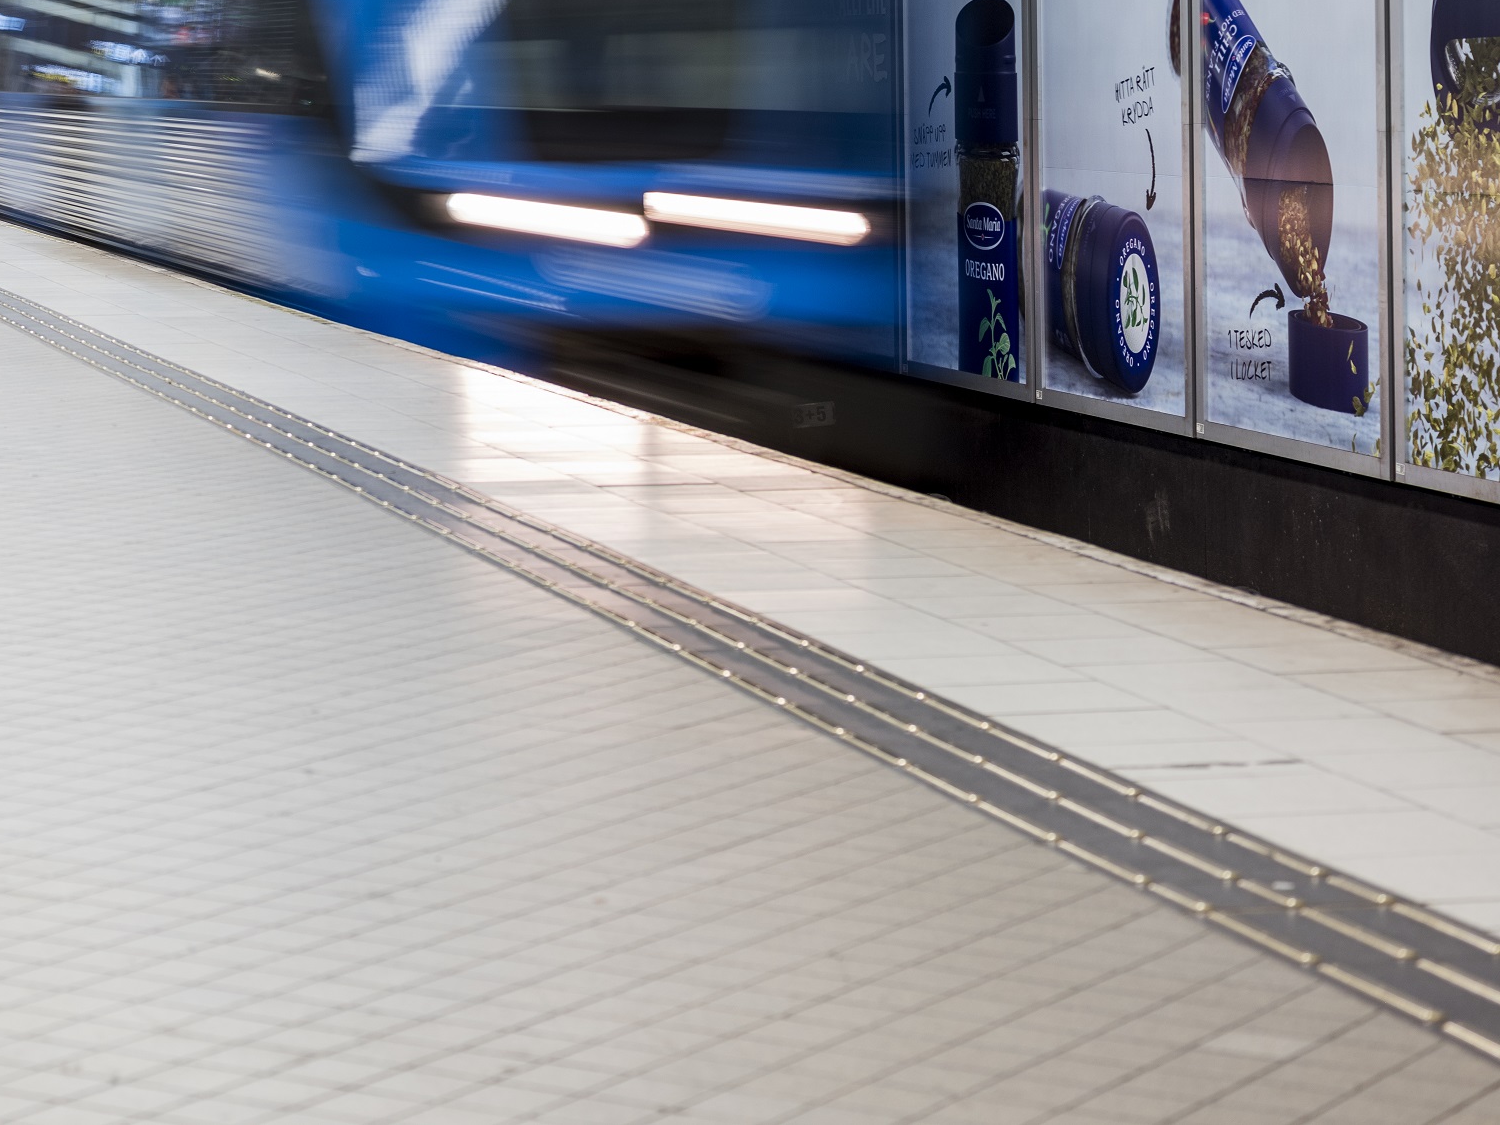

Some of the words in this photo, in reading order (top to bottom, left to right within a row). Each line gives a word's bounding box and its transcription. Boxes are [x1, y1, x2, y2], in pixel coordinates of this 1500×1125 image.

[1214, 24, 1238, 74] CHILI
[1235, 39, 1254, 63] Santa
[1121, 95, 1155, 127] KRYDDA
[966, 214, 983, 231] Santa
[983, 216, 1001, 232] Maria
[1119, 237, 1146, 267] OREGANO
[965, 258, 1005, 282] OREGANO
[1114, 299, 1135, 368] OREGANO
[1143, 282, 1156, 362] OREGANO
[1233, 328, 1272, 351] TESKED
[1236, 358, 1272, 382] LOCKET
